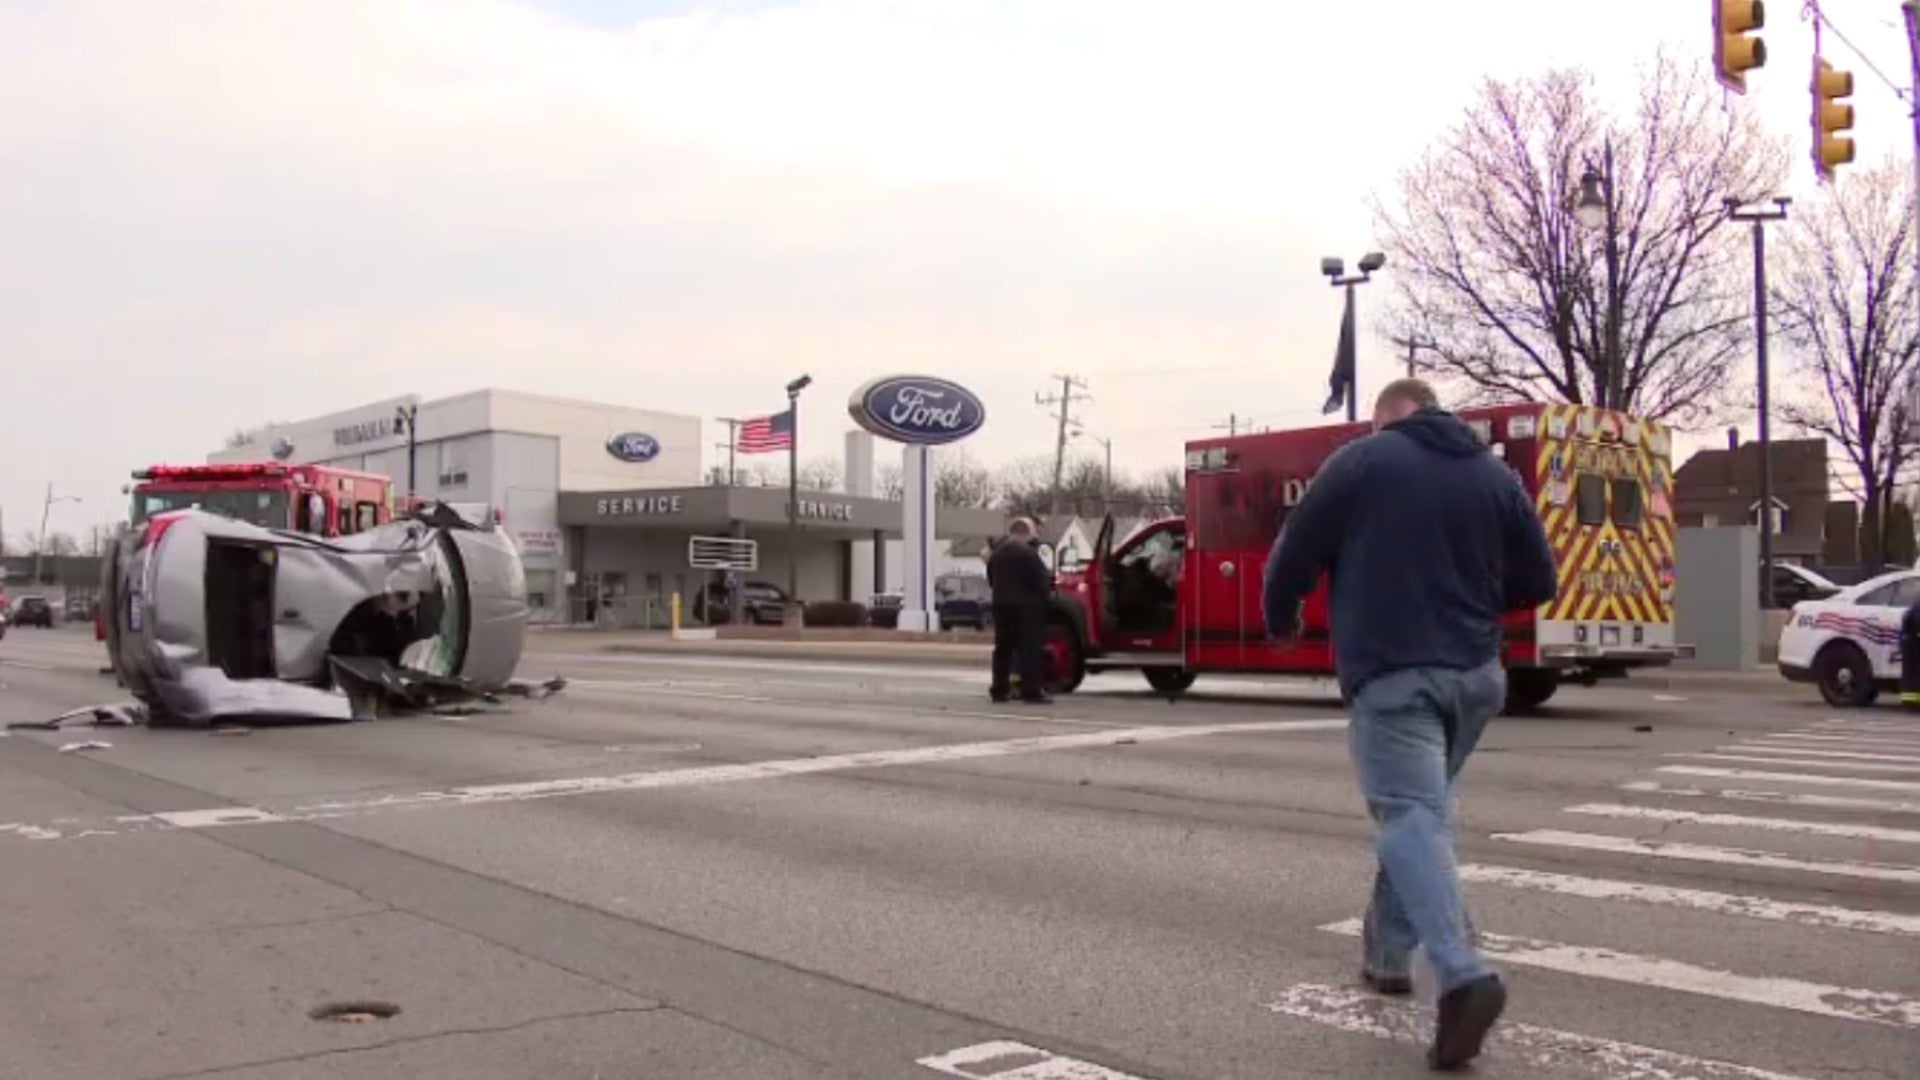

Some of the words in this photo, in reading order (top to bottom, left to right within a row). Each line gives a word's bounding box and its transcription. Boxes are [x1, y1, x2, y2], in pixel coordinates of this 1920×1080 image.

[890, 386, 962, 428] Ford
[597, 494, 682, 515] SERVICE
[788, 501, 852, 521] ERVICE
